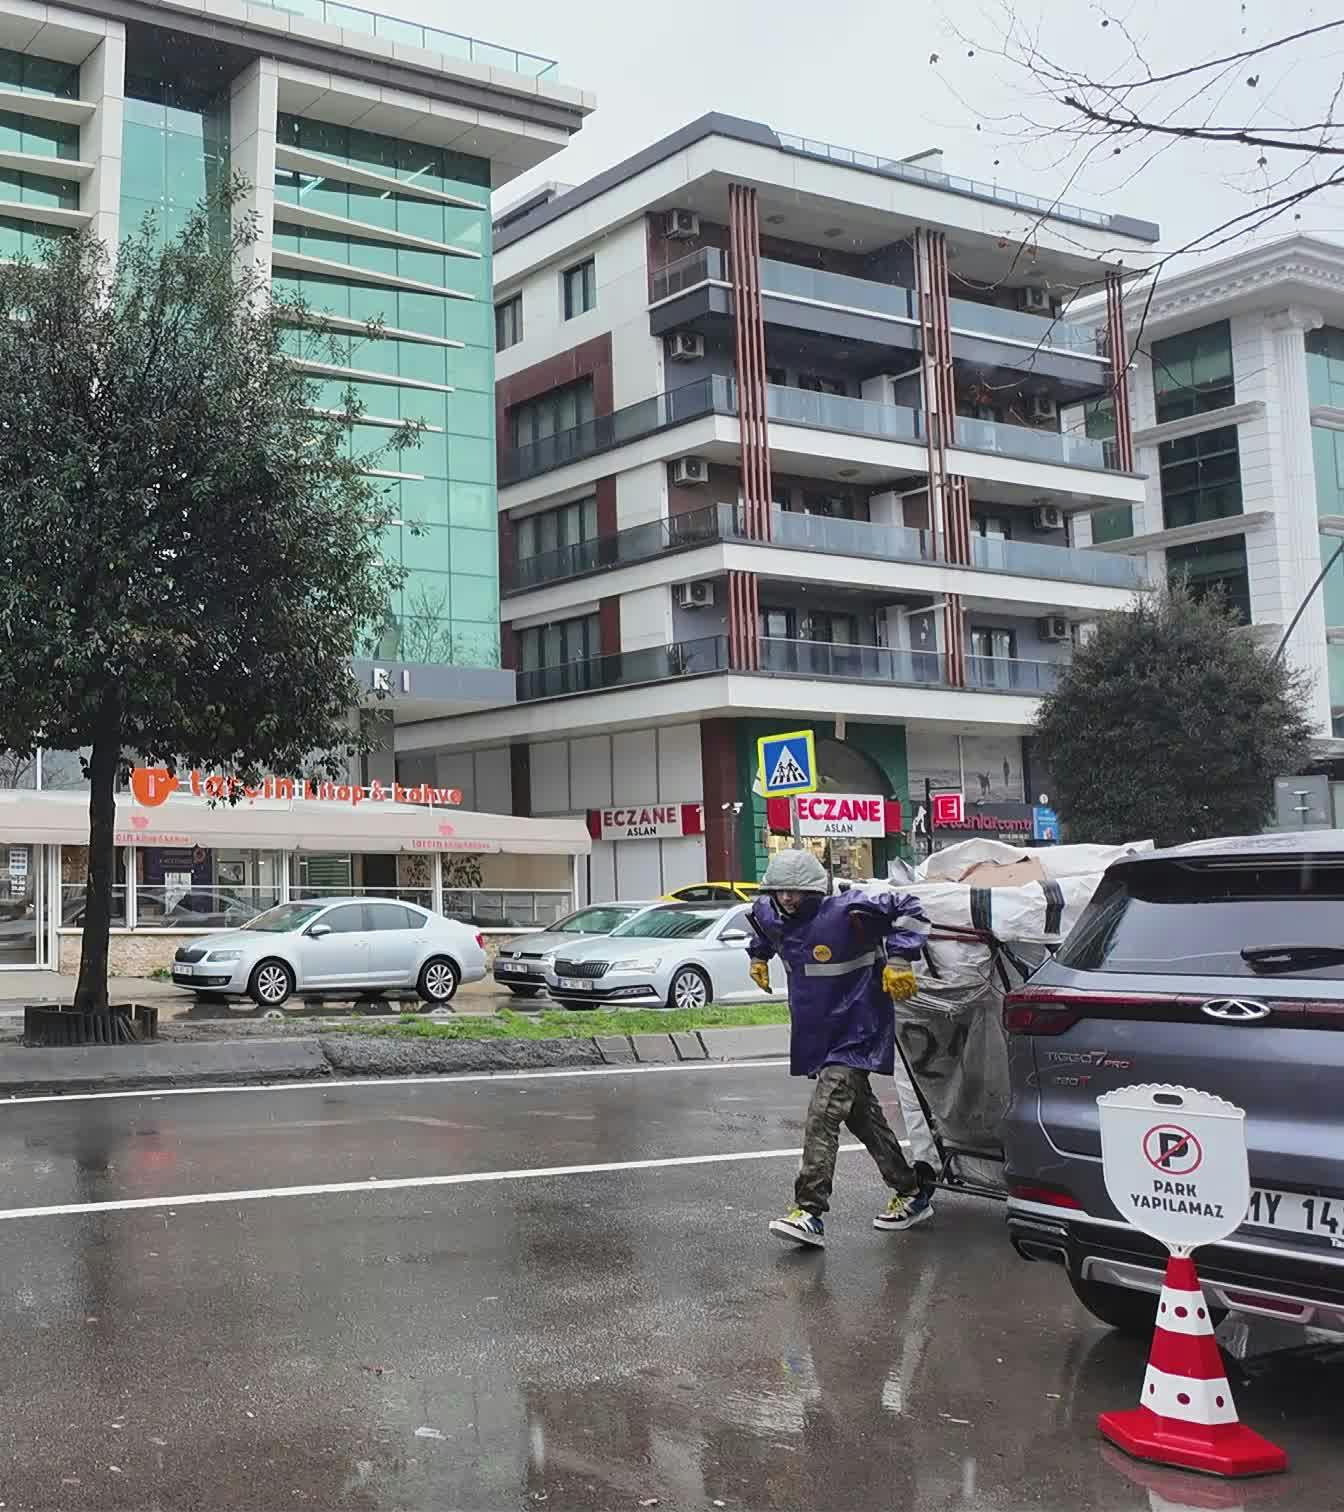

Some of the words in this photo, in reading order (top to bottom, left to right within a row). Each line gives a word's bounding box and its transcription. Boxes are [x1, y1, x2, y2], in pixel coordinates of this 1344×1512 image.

[303, 778, 365, 806] kitap
[371, 780, 386, 800] &
[392, 782, 464, 804] kahve
[603, 807, 677, 827] ECZANE
[797, 798, 881, 822] ECZANE
[627, 826, 657, 837] ASLAN
[824, 823, 853, 833] ASLAN
[1153, 1180, 1197, 1198] PARK
[1130, 1193, 1225, 1219] YAPILAMAZ
[1302, 1198, 1344, 1235] 14
